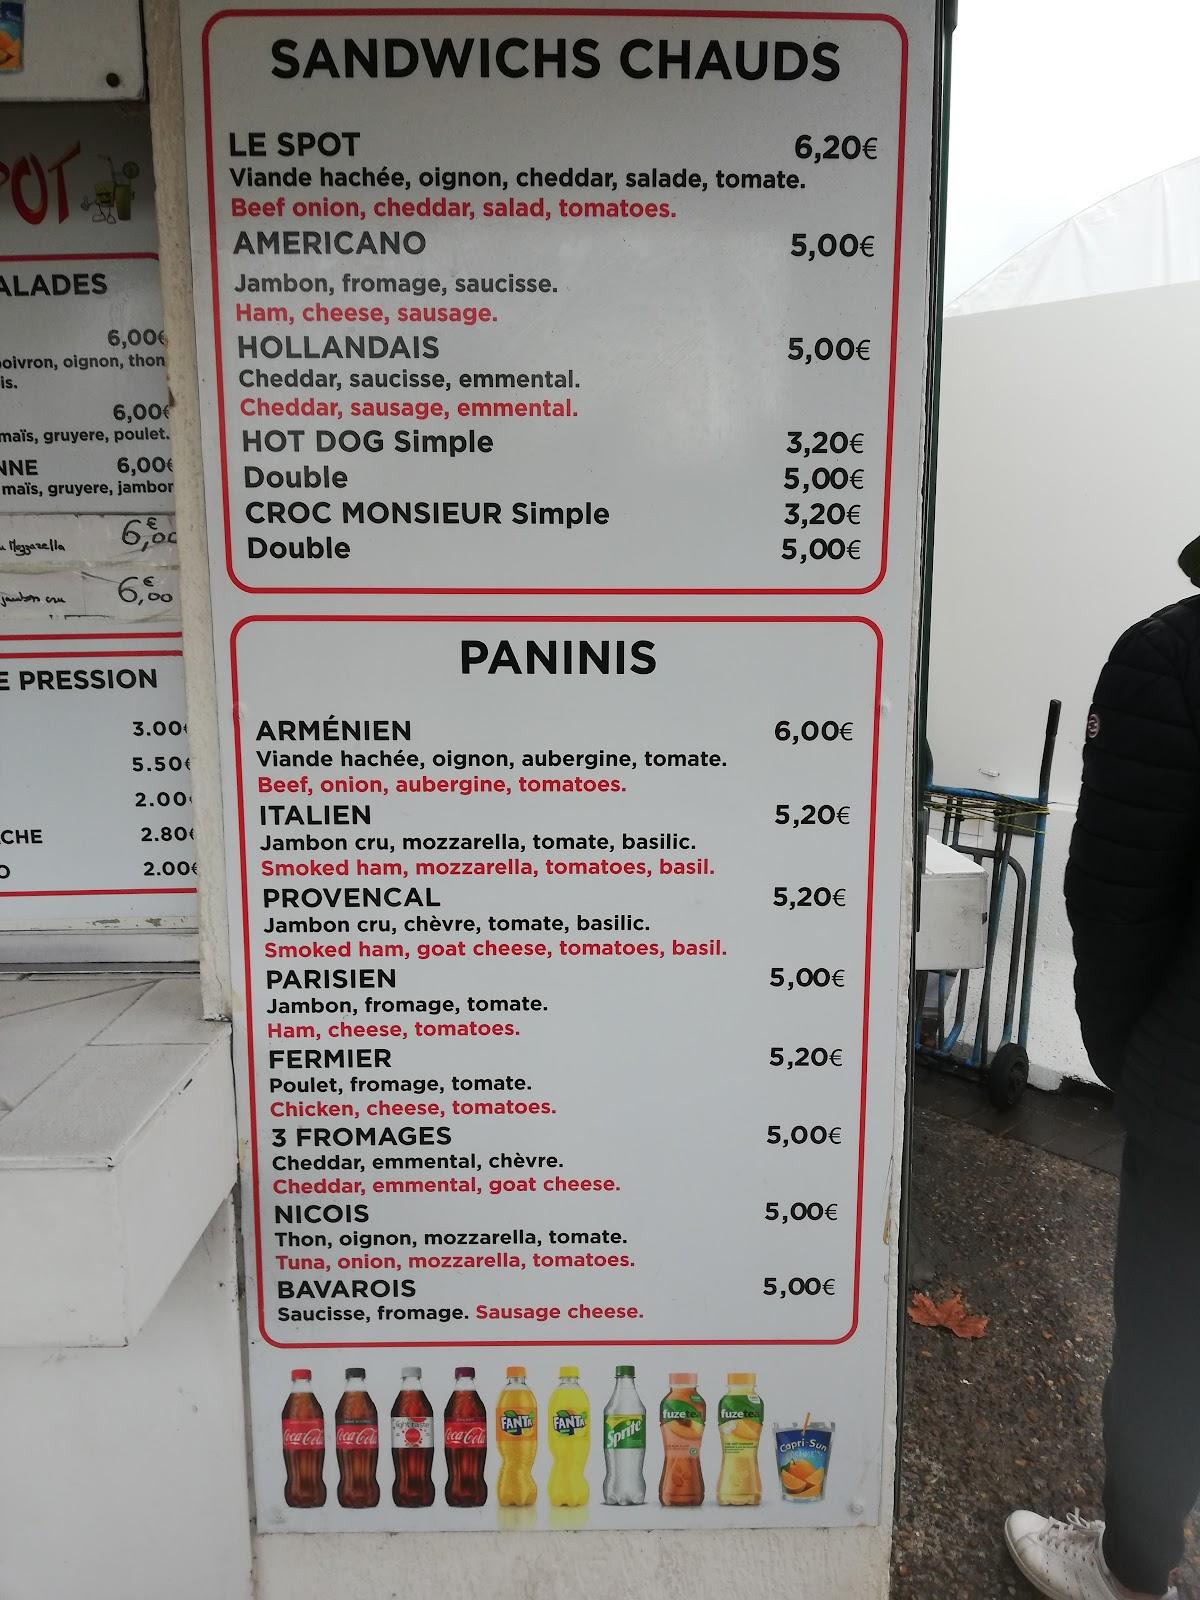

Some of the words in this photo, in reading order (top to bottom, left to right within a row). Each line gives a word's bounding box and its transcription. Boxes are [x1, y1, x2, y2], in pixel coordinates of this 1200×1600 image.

[271, 37, 600, 79] SANDWICHS
[620, 38, 840, 82] CHAUDS
[229, 132, 266, 157] LE
[277, 132, 360, 158] SPOT
[795, 134, 877, 164] 6,20€
[229, 167, 312, 187] Viande
[320, 166, 410, 191] hachée,
[419, 167, 508, 191] oignon,
[516, 167, 617, 191] cheddar,
[625, 168, 707, 192] salade,
[716, 170, 805, 189] tomate.
[232, 197, 285, 217] Beef
[292, 197, 366, 220] onion,
[374, 197, 474, 220] cheddar,
[483, 197, 551, 221] salad,
[559, 199, 676, 218] tomatoes.
[233, 231, 426, 255] AMERICANO
[791, 233, 874, 262] 5,00€
[234, 273, 334, 296] Jambon,
[342, 273, 447, 296] fromage,
[455, 274, 557, 293] saucisse.
[236, 303, 294, 325] Ham,
[303, 303, 389, 325] cheese,
[398, 307, 497, 325] sausage.
[238, 336, 439, 359] HOLLANDAIS
[788, 337, 870, 365] 5,00€
[63, 354, 124, 371] oignon,
[239, 369, 341, 391] Cheddar,
[350, 369, 451, 391] saucisse,
[459, 370, 580, 388] emmental.
[240, 398, 342, 420] Cheddar,
[351, 402, 449, 420] sausage,
[458, 398, 577, 416] emmental.
[43, 430, 109, 445] gruyere,
[114, 428, 170, 444] poulet.
[243, 430, 305, 452] HOT
[316, 430, 383, 453] DOG
[395, 429, 493, 457] Simple
[786, 431, 864, 458] 3,20€
[244, 465, 348, 488] Double
[784, 467, 864, 494] 5,00€
[2, 480, 43, 497] maïs,
[47, 482, 113, 497] gruyere,
[246, 501, 332, 524] CROC
[343, 502, 501, 524] MONSIEUR
[512, 502, 609, 529] Simple
[784, 503, 861, 529] 3,20€
[248, 536, 350, 559] Double
[781, 538, 861, 564] 5,00€
[461, 640, 656, 674] PANINIS
[19, 669, 157, 690] PRESSION
[256, 714, 411, 741] ARMÉNIEN
[775, 721, 853, 745] 6,00€
[256, 750, 333, 767] Viande
[341, 749, 424, 770] hachée,
[433, 750, 514, 770] oignon,
[522, 750, 637, 770] aubergine,
[644, 751, 726, 766] tomate.
[258, 776, 313, 796] Beef,
[320, 776, 388, 795] onion,
[396, 776, 511, 795] aubergine,
[519, 777, 626, 792] tomatoes.
[135, 792, 192, 807] 2.00
[260, 805, 370, 825] ITALIEN
[775, 805, 850, 828] 5,20€
[0, 829, 43, 844] CHE
[260, 834, 347, 851] Jambon
[355, 838, 394, 853] cru,
[403, 833, 525, 852] mozzarella,
[533, 834, 614, 852] tomate,
[623, 833, 695, 849] basilic.
[262, 859, 349, 876] Smoked
[357, 859, 408, 878] ham,
[416, 858, 538, 877] mozzarella,
[546, 860, 651, 877] tomatoes,
[660, 858, 714, 874] basil.
[264, 887, 441, 908] PROVENCAL
[773, 887, 846, 910] 5,20€
[264, 917, 349, 933] Jambon
[357, 920, 396, 935] cru,
[404, 915, 481, 934] chèvre,
[488, 916, 569, 934] tomate,
[577, 915, 649, 931] basilic.
[265, 941, 351, 958] Smoked
[359, 941, 409, 959] ham,
[417, 941, 466, 959] goat
[472, 940, 552, 958] cheese,
[559, 941, 664, 958] tomatoes,
[673, 940, 726, 955] basil.
[267, 969, 395, 989] PARISIEN
[770, 968, 845, 991] 5,00€
[267, 998, 357, 1016] Jambon,
[365, 997, 460, 1015] fromage,
[467, 997, 547, 1011] tomate.
[268, 1023, 320, 1040] Ham,
[328, 1022, 407, 1039] cheese,
[415, 1021, 519, 1036] tomatoes.
[269, 1049, 391, 1069] FERMIER
[770, 1047, 842, 1070] 5,20€
[270, 1077, 343, 1095] Poulet,
[350, 1077, 444, 1094] fromage,
[451, 1076, 531, 1091] tomate.
[270, 1101, 359, 1119] Chicken,
[367, 1100, 445, 1118] cheese,
[452, 1100, 556, 1114] tomatoes.
[272, 1129, 286, 1147] 3
[297, 1126, 451, 1147] FROMAGES
[767, 1126, 841, 1148] 5,00€
[272, 1155, 365, 1173] Cheddar,
[372, 1153, 481, 1171] emmental,
[489, 1152, 563, 1168] chèvre.
[273, 1178, 365, 1196] Cheddar,
[373, 1177, 481, 1194] emmental,
[489, 1177, 536, 1194] goat
[544, 1176, 620, 1191] cheese.
[275, 1204, 369, 1224] NICOIS
[765, 1201, 837, 1224] 5,00€
[274, 1232, 332, 1249] Thon,
[339, 1231, 417, 1249] oignon,
[425, 1229, 542, 1247] mozzarella,
[549, 1230, 627, 1244] tomate.
[276, 1255, 330, 1272] Tuna,
[338, 1254, 401, 1271] onion,
[409, 1252, 525, 1270] mozzarella,
[533, 1253, 634, 1267] tomatoes.
[278, 1279, 416, 1299] BAVAROIS
[763, 1277, 835, 1299] 5,00€
[278, 1306, 370, 1323] Saucisse,
[377, 1305, 468, 1322] fromage.
[476, 1305, 560, 1321] Sausage
[568, 1304, 643, 1319] cheese.
[606, 1420, 642, 1448] Sprite
[780, 1438, 827, 1452] Capri-Sun
